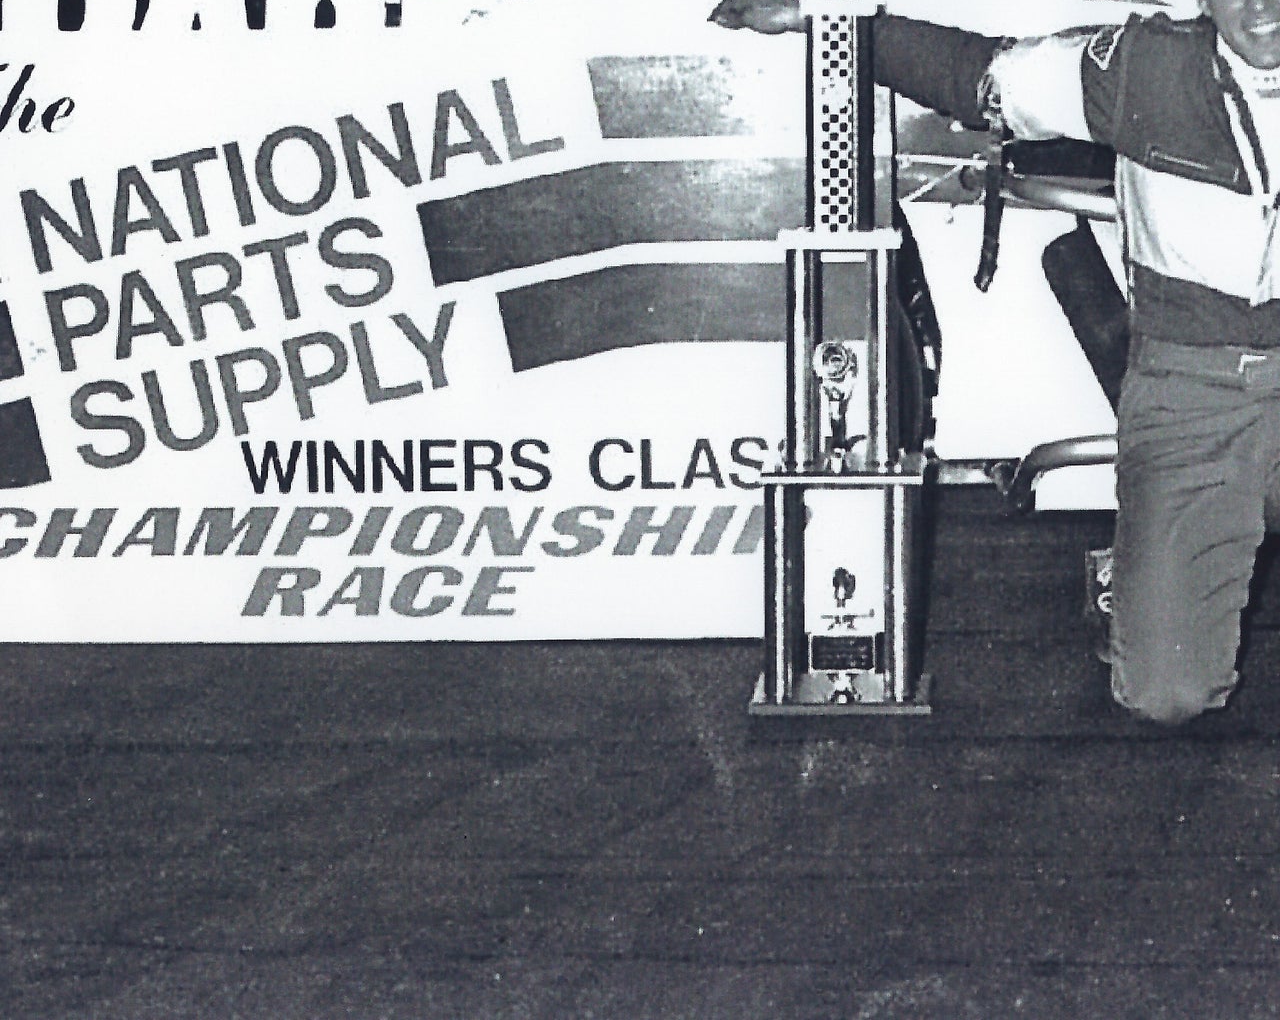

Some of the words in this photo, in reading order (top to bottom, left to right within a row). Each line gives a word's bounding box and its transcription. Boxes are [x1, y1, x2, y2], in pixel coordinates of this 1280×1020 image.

[0, 63, 75, 134] he
[19, 77, 565, 273] NATIONAL
[42, 216, 394, 373] PARTS
[69, 301, 457, 470] SUPPLY
[240, 438, 552, 494] WINNERS
[239, 566, 536, 619] RACE
